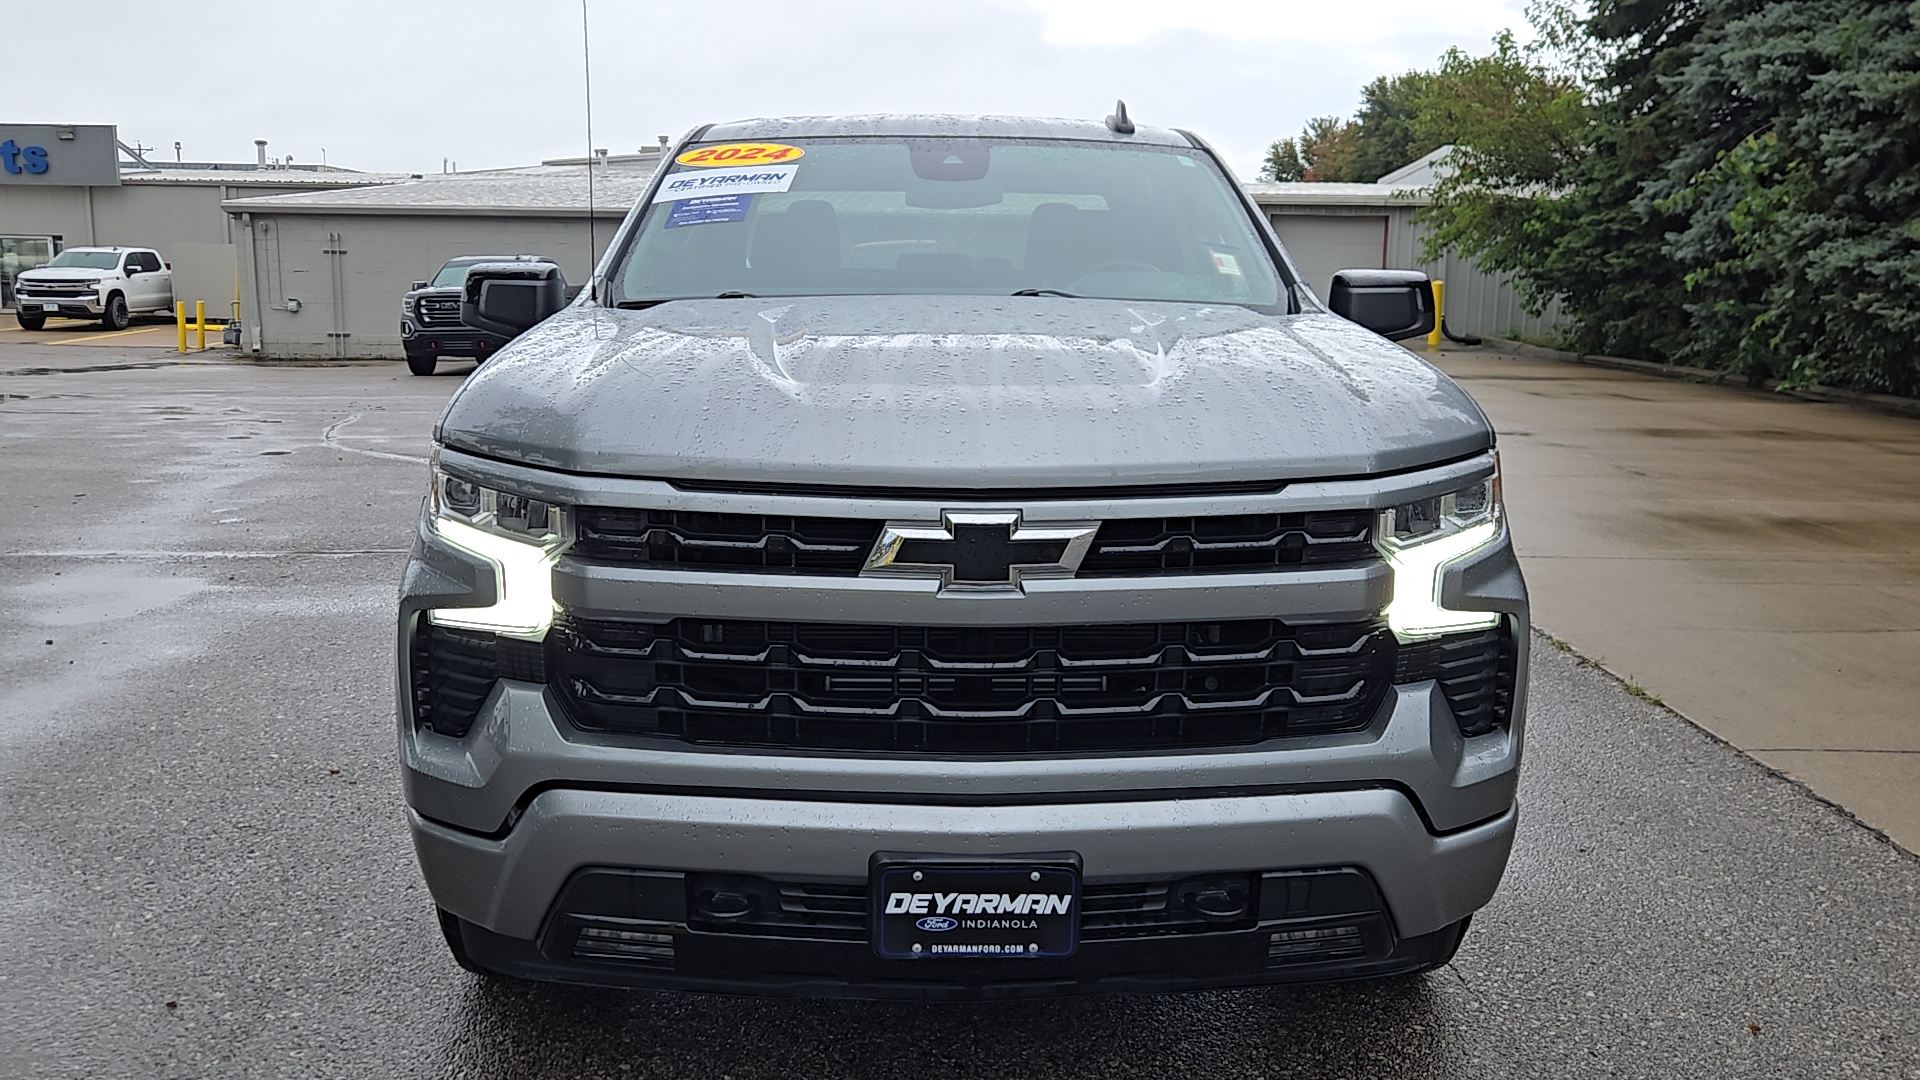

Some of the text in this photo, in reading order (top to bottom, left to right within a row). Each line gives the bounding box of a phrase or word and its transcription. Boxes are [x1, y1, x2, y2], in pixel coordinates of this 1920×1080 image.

[685, 147, 795, 163] 2024
[667, 172, 788, 189] DEYARMAN
[885, 892, 1072, 915] DEYARMAN
[924, 918, 1038, 929] Ford INDIANOLA
[931, 944, 1024, 954] DEYARMANFORD.COM
